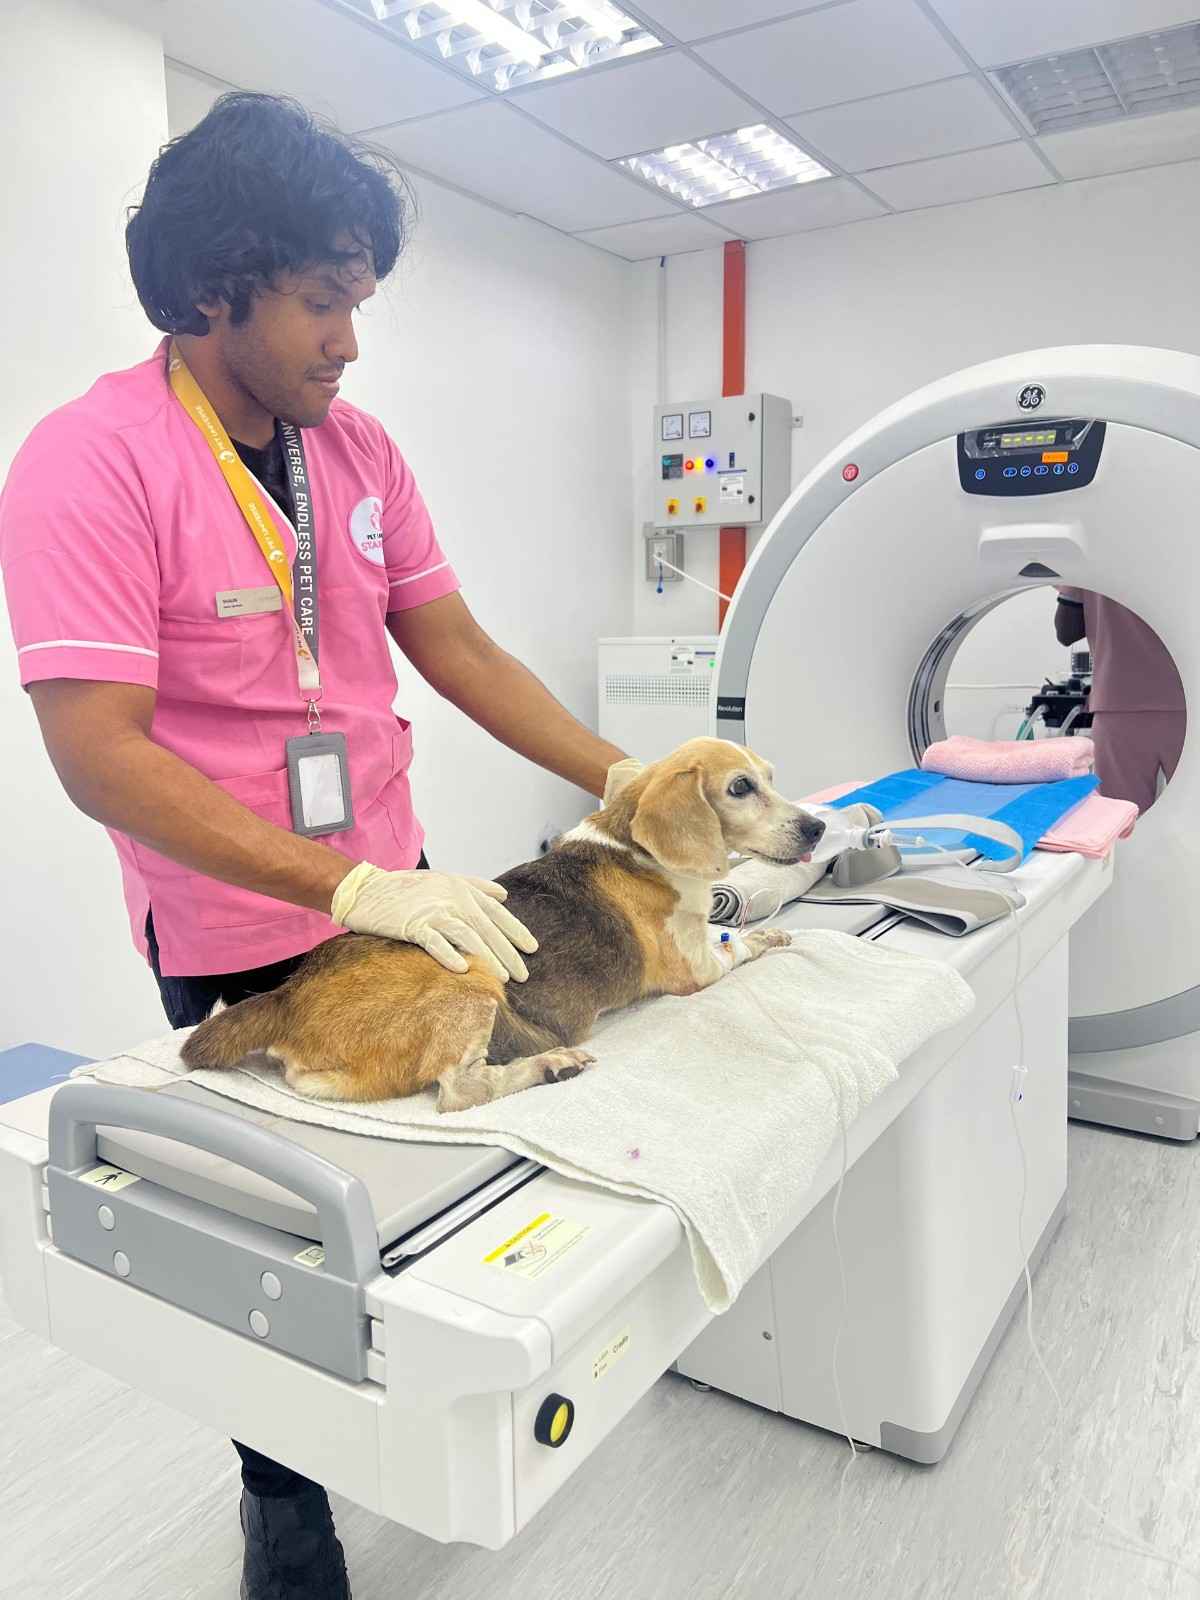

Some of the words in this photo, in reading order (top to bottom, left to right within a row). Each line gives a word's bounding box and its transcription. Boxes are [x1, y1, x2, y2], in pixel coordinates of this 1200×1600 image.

[295, 492, 312, 560] ENDLESS
[300, 565, 313, 592] PET
[301, 597, 313, 635] CARE
